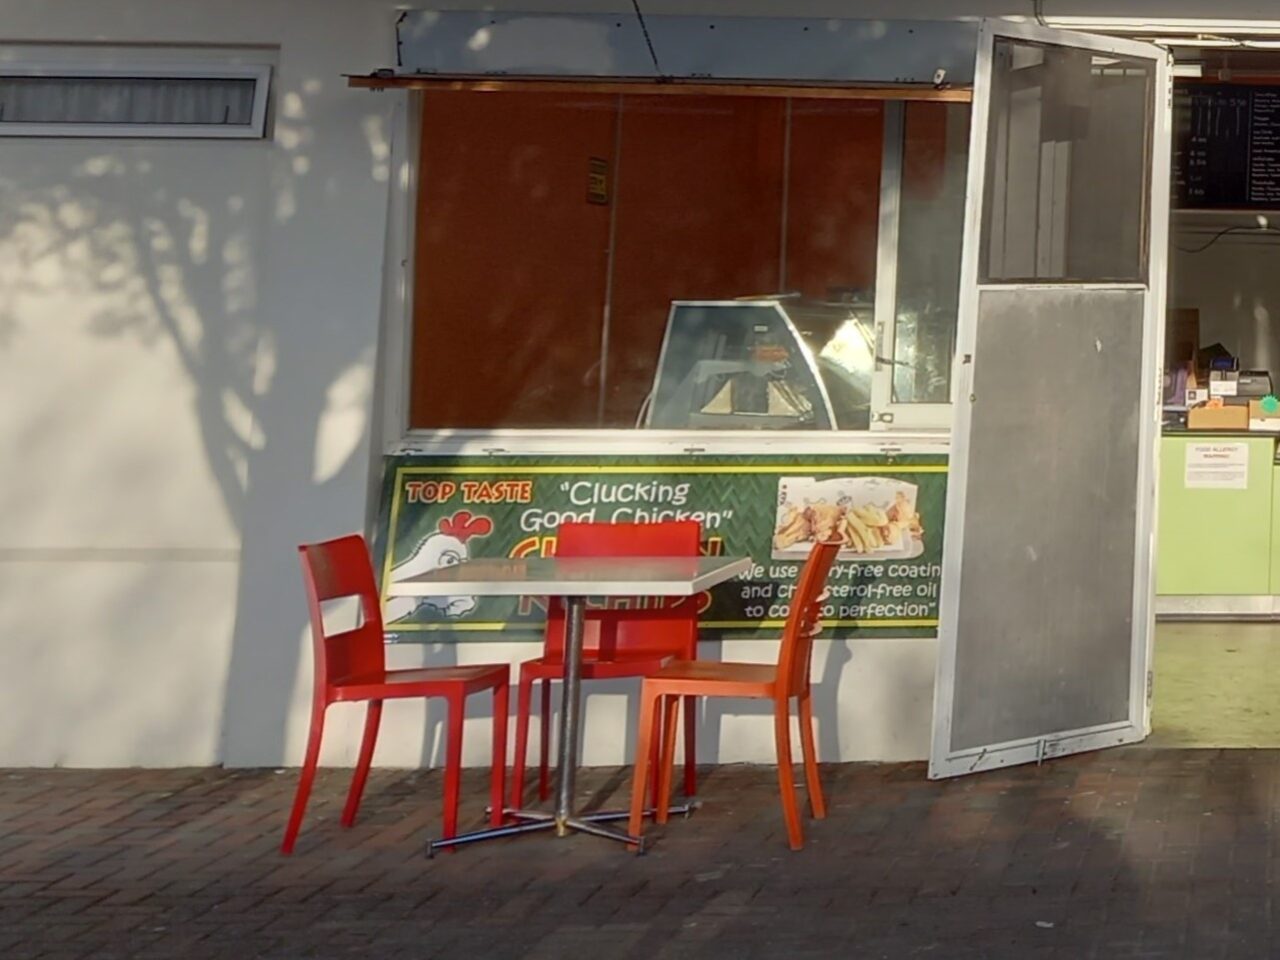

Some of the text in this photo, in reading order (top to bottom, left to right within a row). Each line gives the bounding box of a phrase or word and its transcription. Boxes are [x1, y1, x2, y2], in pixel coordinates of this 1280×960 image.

[405, 480, 533, 503] TOP TASTE
[560, 480, 690, 506] "Clucking
[520, 507, 596, 532] Good
[769, 565, 798, 580] use
[741, 583, 773, 599] and
[917, 582, 937, 598] oil
[745, 605, 764, 618] to
